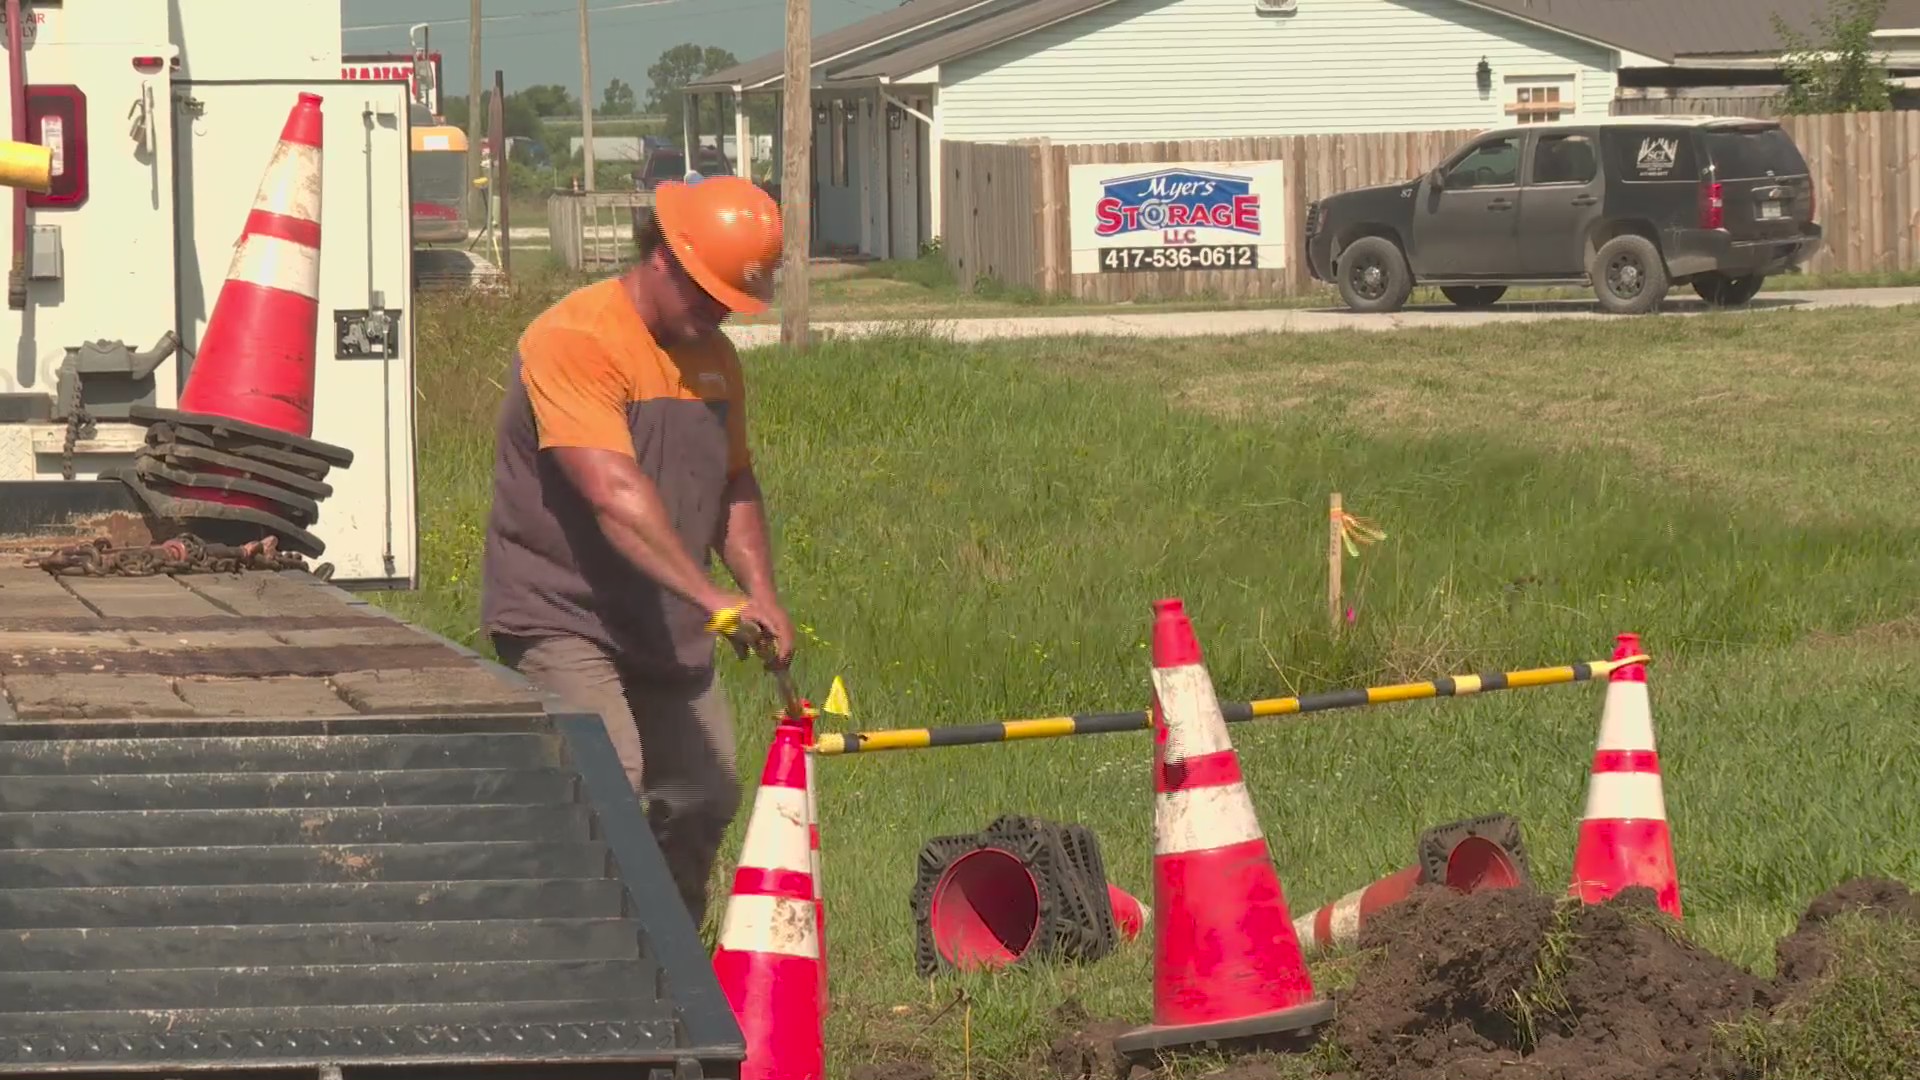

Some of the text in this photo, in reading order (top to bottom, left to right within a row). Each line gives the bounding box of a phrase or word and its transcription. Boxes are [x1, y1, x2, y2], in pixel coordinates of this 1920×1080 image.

[26, 13, 45, 24] AIR
[1137, 176, 1216, 203] Myers
[1095, 194, 1261, 237] STORAGE
[1163, 229, 1197, 244] LLC
[1105, 247, 1252, 269] 417-536-0612
